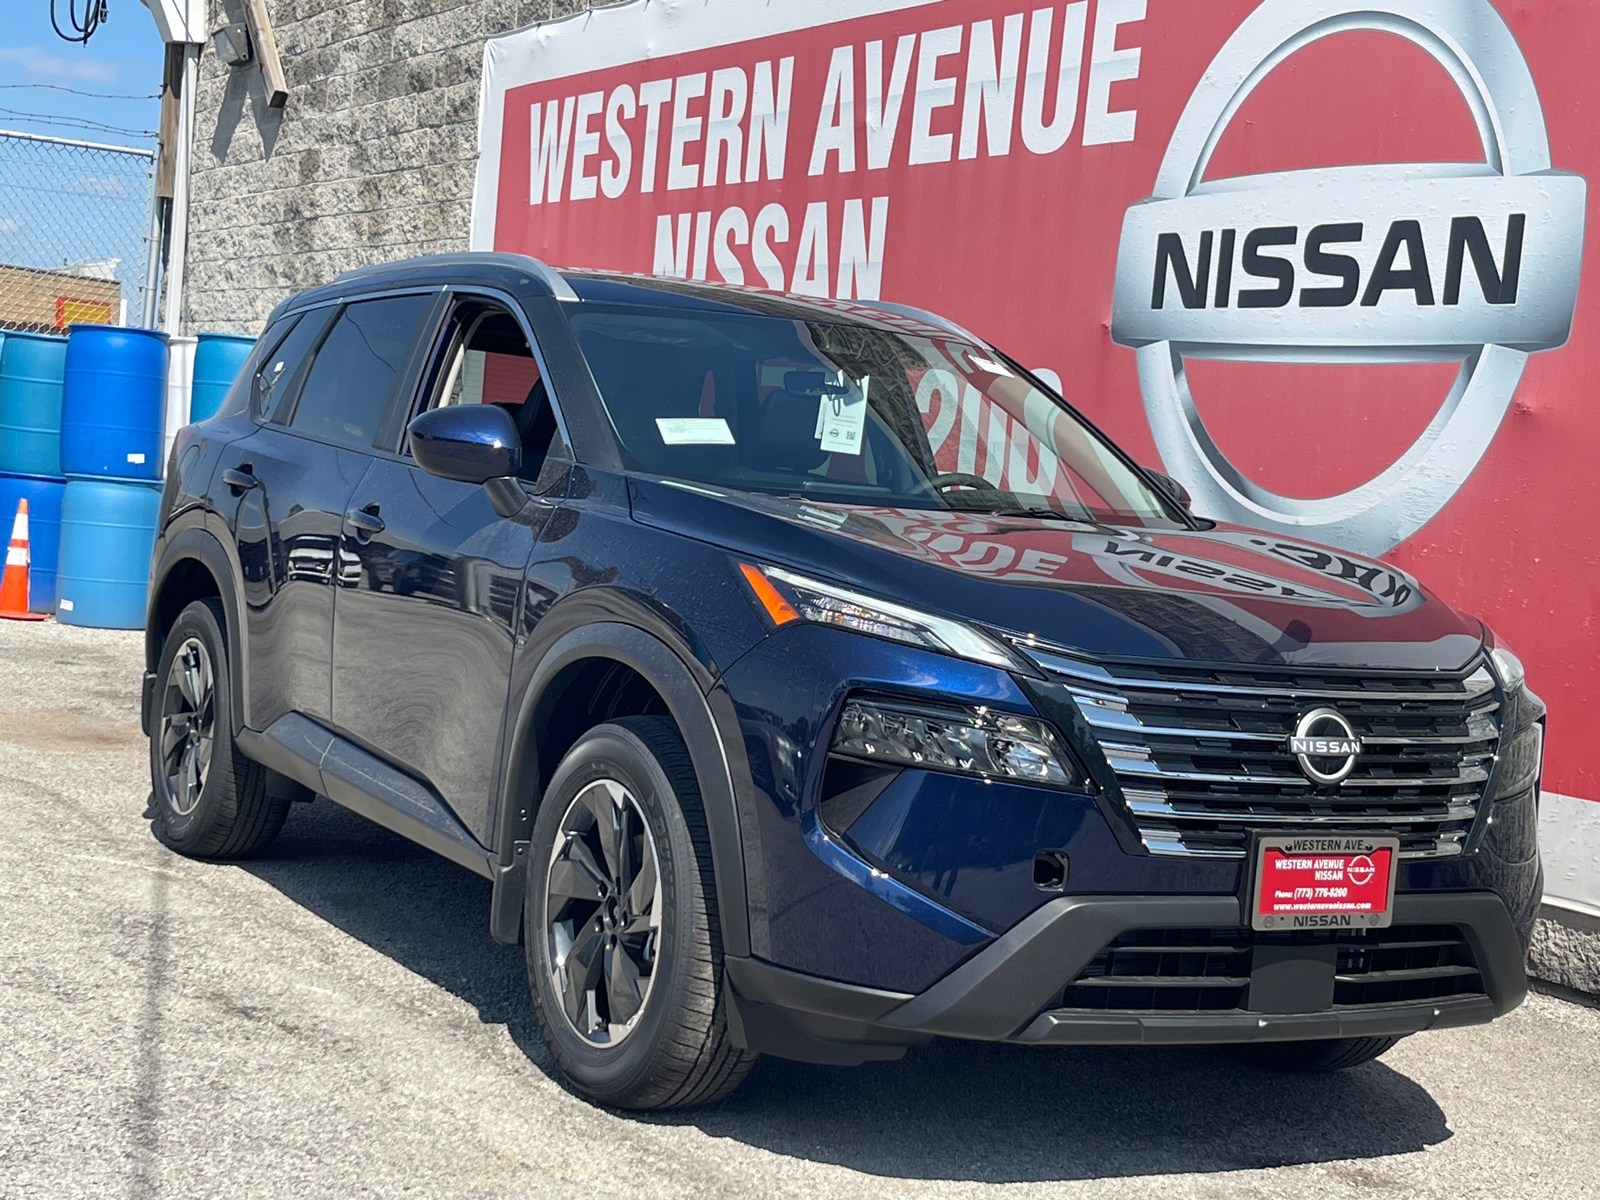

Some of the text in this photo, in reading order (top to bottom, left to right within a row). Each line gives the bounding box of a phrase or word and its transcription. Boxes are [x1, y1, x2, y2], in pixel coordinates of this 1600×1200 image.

[529, 0, 1147, 206] WESTERN AVENUE
[1151, 213, 1526, 309] NISSAN
[1293, 740, 1359, 753] NISSAN
[1293, 840, 1341, 851] WESTERN
[1275, 859, 1344, 869] WESTERN AVENUE
[1314, 870, 1343, 880] NISSAN
[1294, 887, 1313, 899] (773)
[1293, 915, 1350, 927] NISSAN
